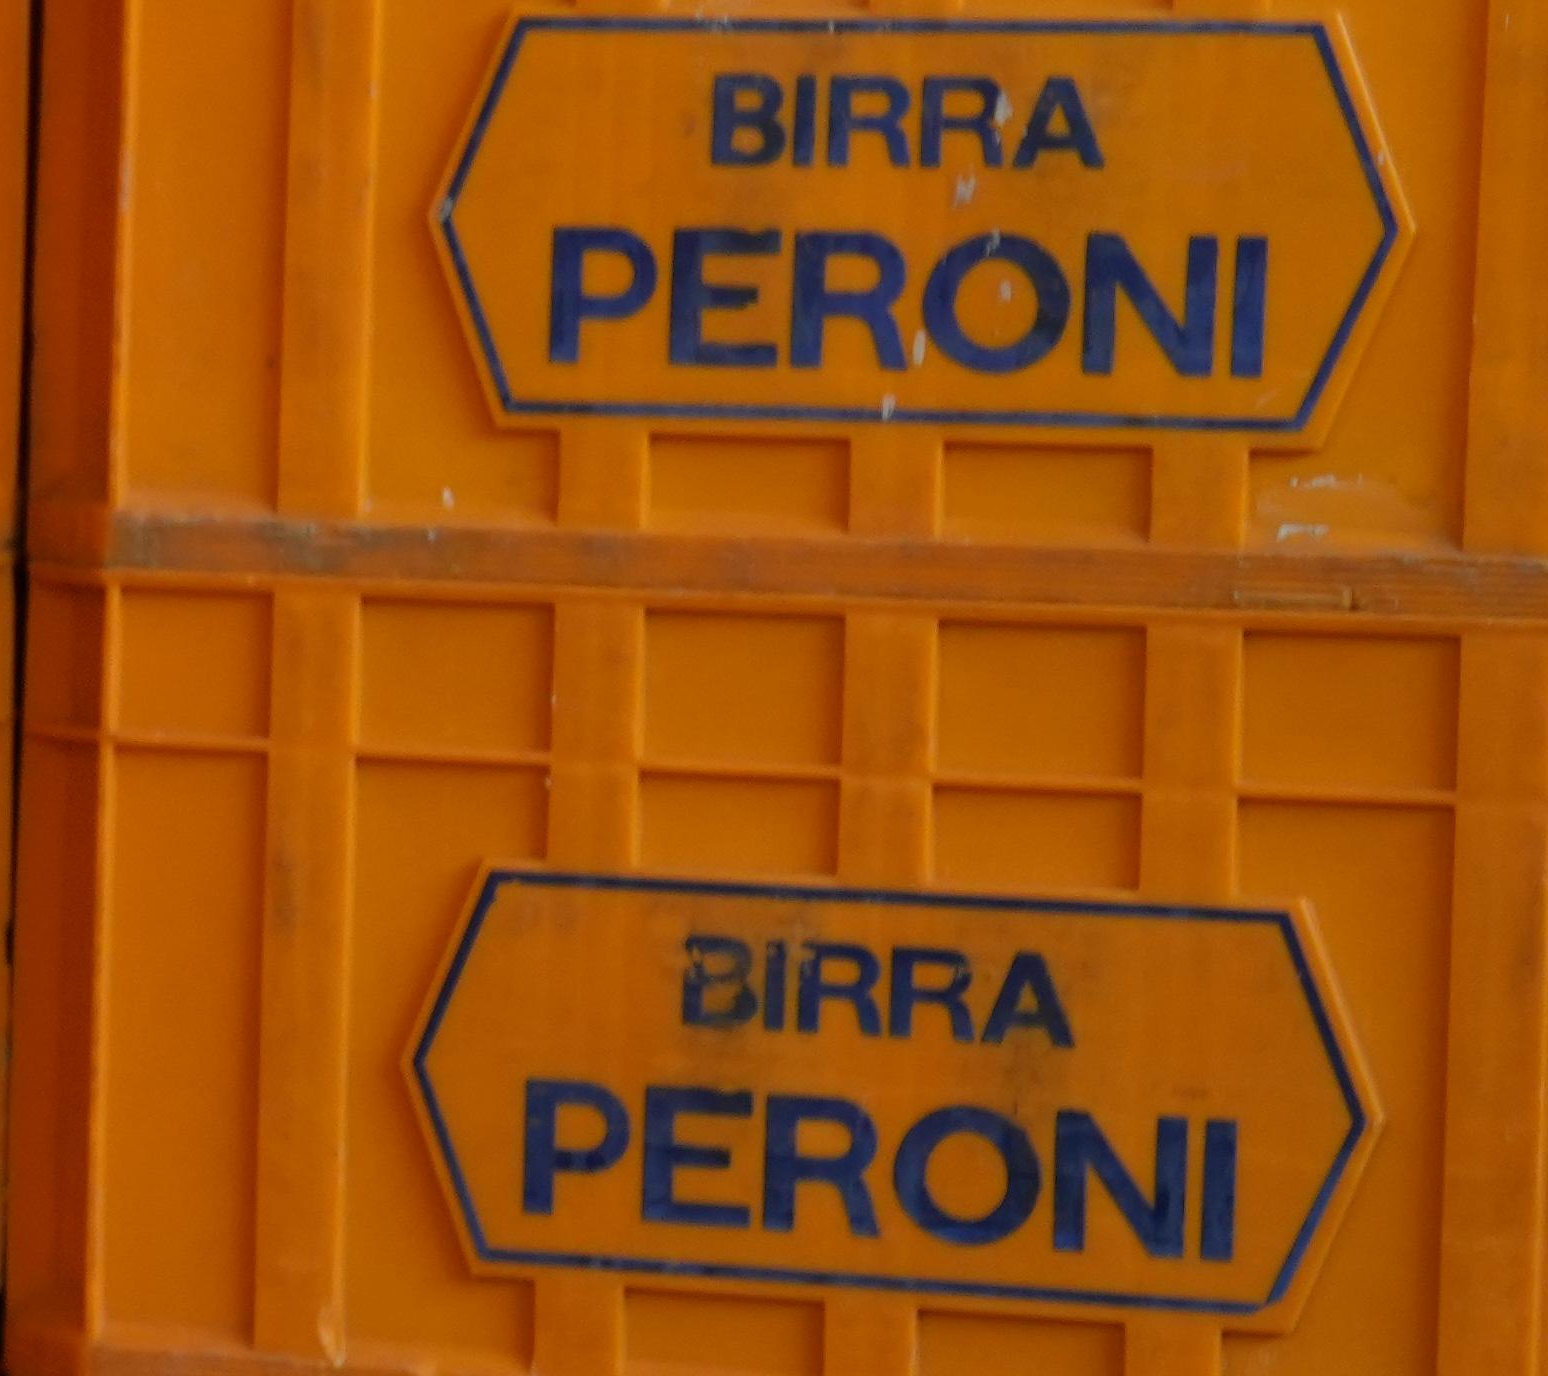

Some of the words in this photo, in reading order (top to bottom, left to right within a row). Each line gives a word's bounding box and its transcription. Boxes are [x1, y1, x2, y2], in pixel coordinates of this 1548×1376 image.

[711, 74, 1105, 168] BIRRA
[549, 226, 1269, 378] PERONI
[681, 934, 1075, 1048] BIRRA
[522, 1079, 1239, 1262] PERONI
